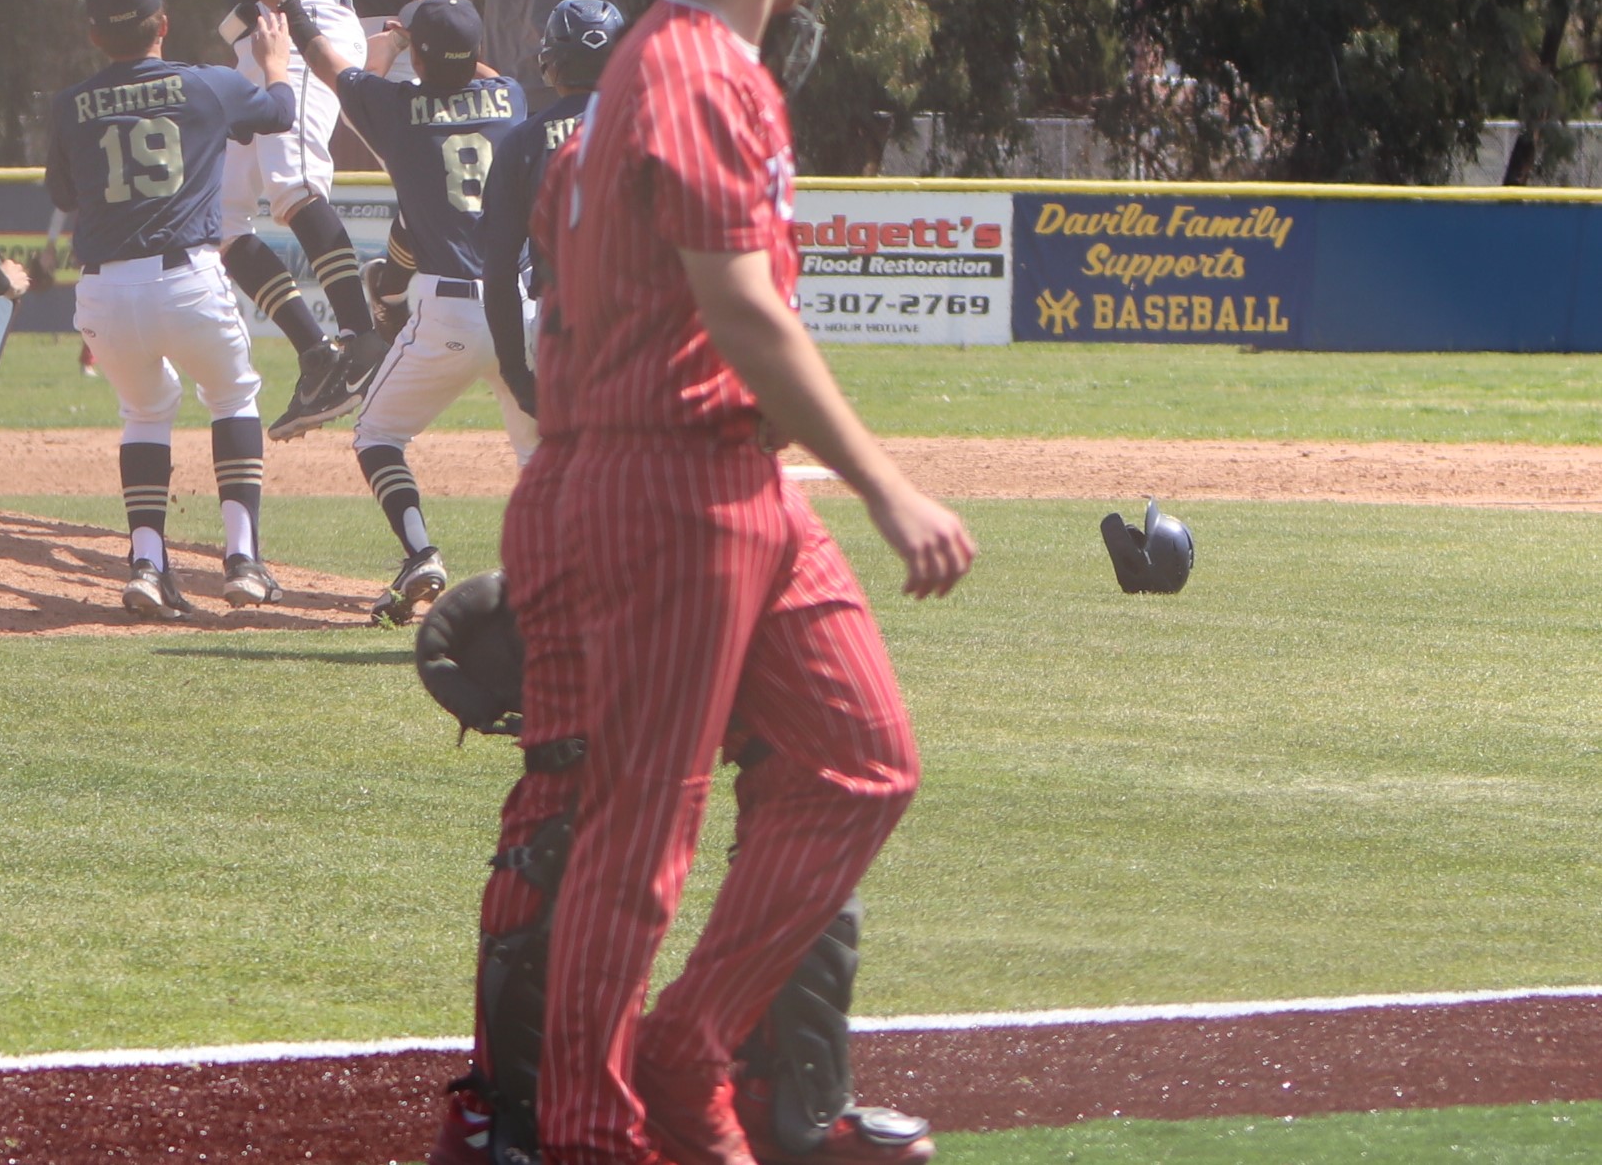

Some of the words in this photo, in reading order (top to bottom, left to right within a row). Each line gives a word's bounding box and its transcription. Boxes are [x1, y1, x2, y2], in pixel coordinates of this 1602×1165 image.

[74, 75, 186, 123] REIMER
[410, 89, 513, 126] MACIAS
[99, 116, 184, 203] 19
[442, 132, 493, 213] 8
[791, 214, 1002, 255] adgett's
[1034, 203, 1161, 236] Davila
[1166, 205, 1293, 248] Family
[803, 256, 863, 274] Flood
[869, 256, 992, 276] Restoration
[1081, 242, 1245, 285] Supports
[794, 292, 990, 315] -307-2769
[1093, 294, 1288, 332] BASEBALL
[825, 323, 861, 332] HOUR
[866, 324, 920, 333] HOTLINE
